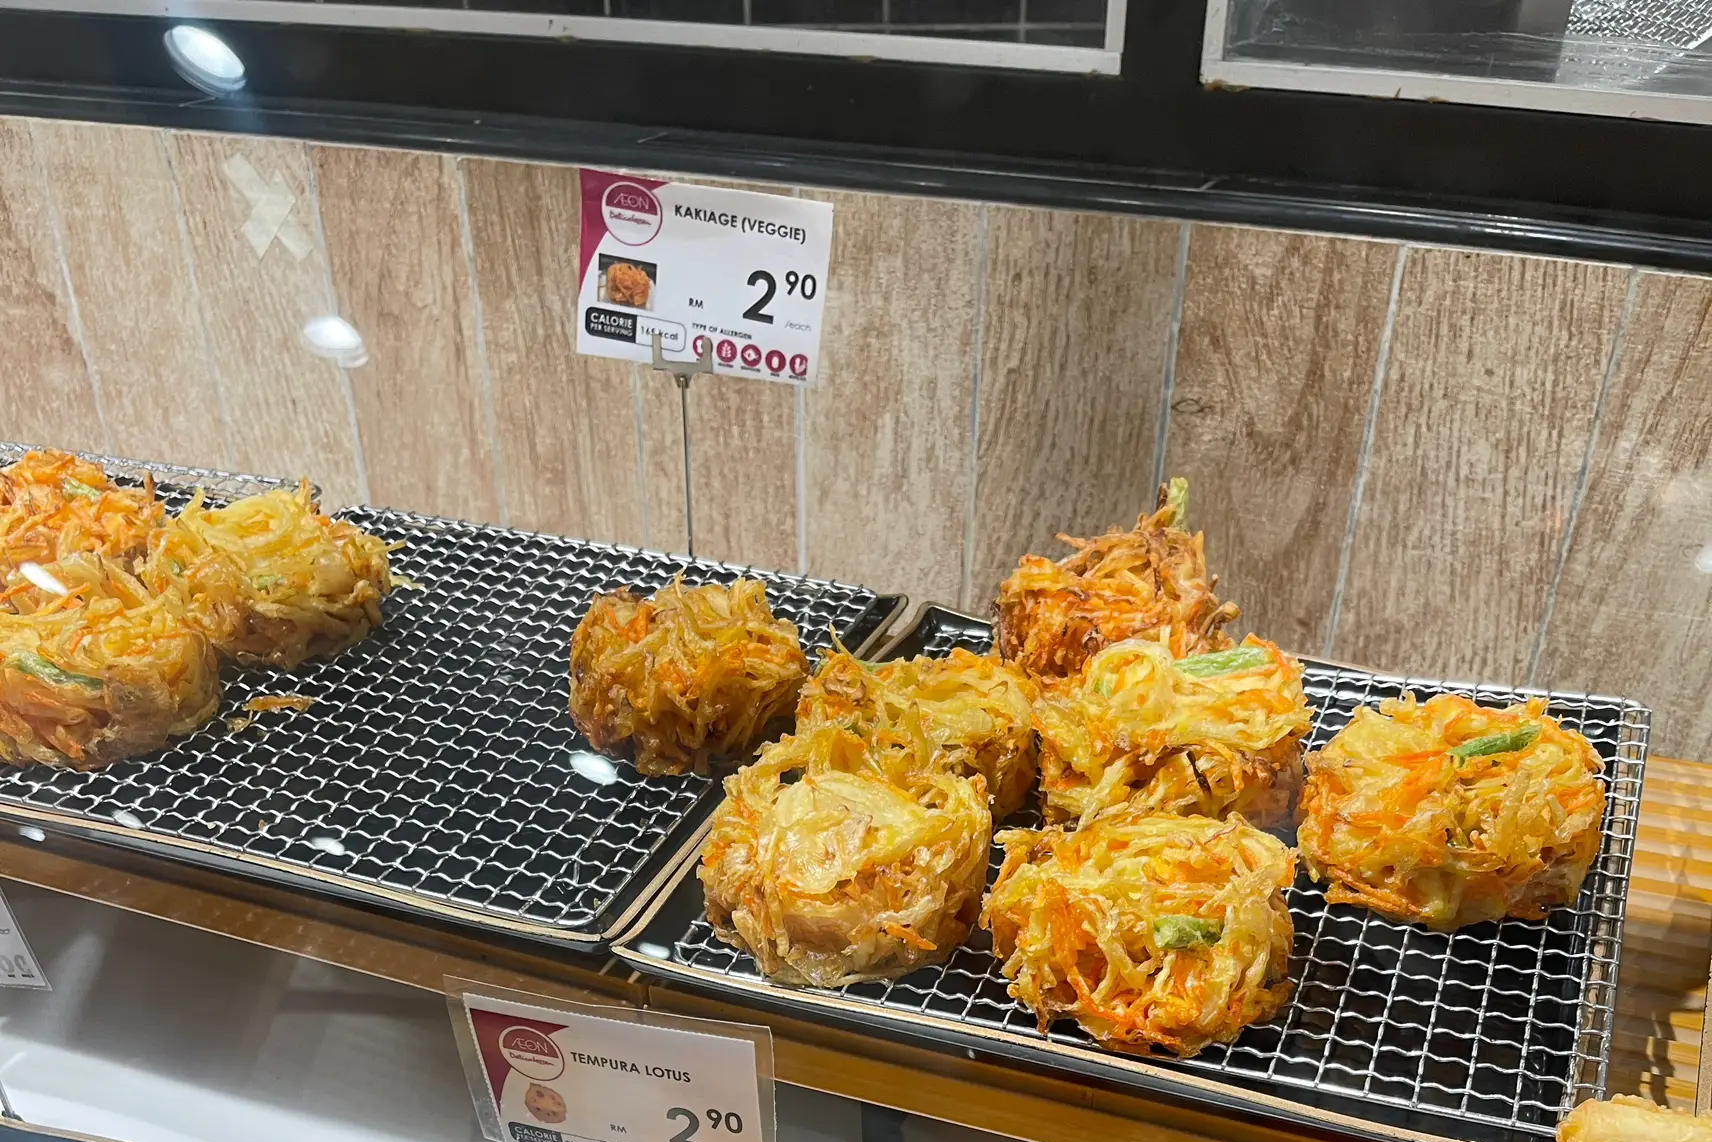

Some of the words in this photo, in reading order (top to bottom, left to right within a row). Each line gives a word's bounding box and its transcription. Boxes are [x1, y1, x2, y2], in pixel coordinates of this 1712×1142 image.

[674, 204, 738, 228] KAKIAGE
[741, 216, 806, 245] (VEGGIE)
[688, 297, 704, 309] RM
[590, 312, 633, 329] CALORIE
[590, 322, 603, 331] PER
[603, 326, 633, 337] SERVING
[692, 322, 707, 332] TYPE
[719, 328, 753, 340] ALLERGEN
[570, 1051, 641, 1075] TEMPURA
[645, 1065, 691, 1083] LOTUS
[514, 1125, 558, 1142] CALORIE
[609, 1123, 628, 1134] RM
